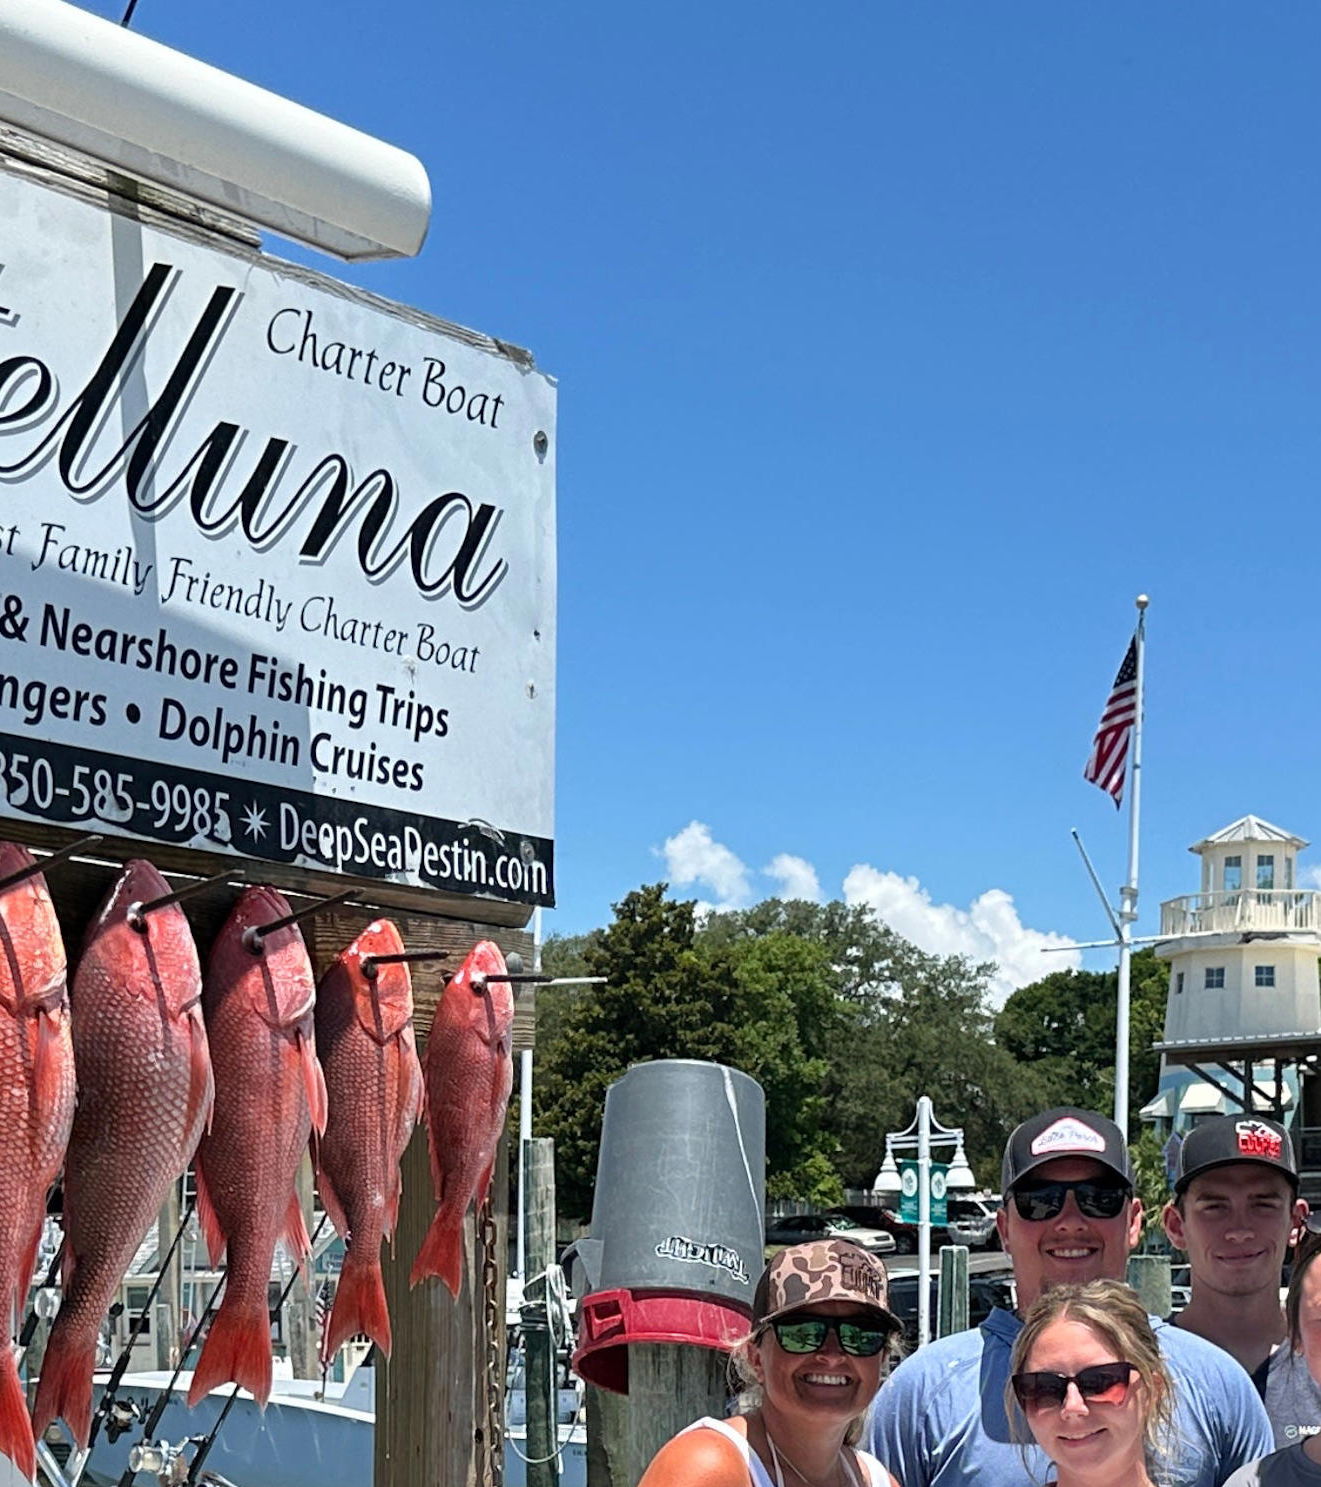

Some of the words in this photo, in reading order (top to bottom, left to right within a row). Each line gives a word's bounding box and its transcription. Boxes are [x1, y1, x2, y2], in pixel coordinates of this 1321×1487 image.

[267, 308, 412, 397] Charter
[422, 357, 505, 428] Boat
[31, 522, 154, 595] Family
[161, 556, 294, 631] Friendly
[300, 596, 409, 657] Charter
[416, 623, 481, 673] Boat
[40, 603, 238, 689] Nearshore
[248, 654, 367, 730] Fishing
[377, 684, 449, 742] Trips
[158, 697, 299, 766] Dolphin
[310, 732, 425, 792] Cruises
[280, 802, 547, 895] DeepSeaDestin.com
